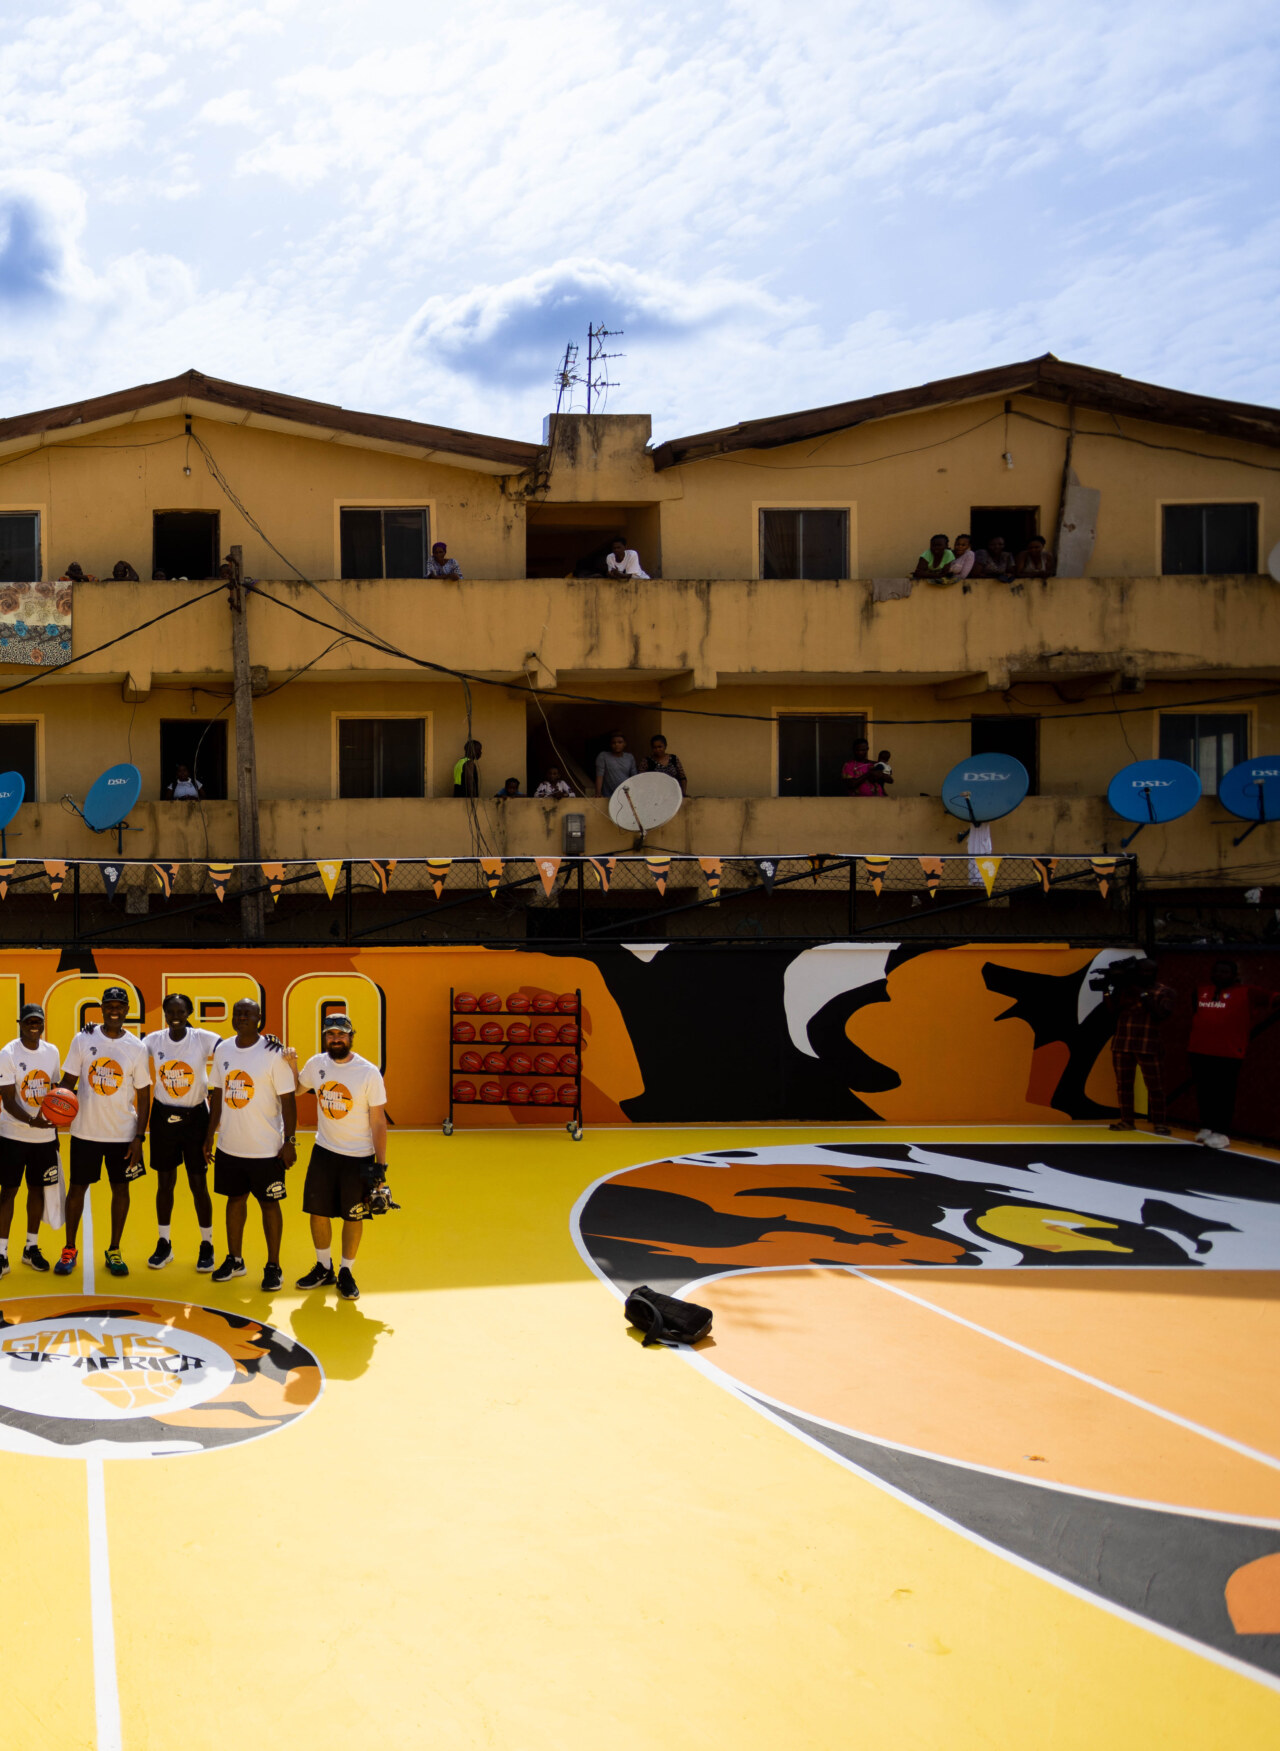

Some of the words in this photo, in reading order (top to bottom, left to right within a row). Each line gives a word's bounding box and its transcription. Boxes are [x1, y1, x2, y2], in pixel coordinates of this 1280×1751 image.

[963, 771, 1010, 781] DStv
[107, 777, 130, 786] DStv
[1131, 779, 1176, 788] DStv
[1, 1328, 180, 1357] GIANTS
[5, 1351, 71, 1362] OF
[72, 1354, 206, 1373] AFRICA
